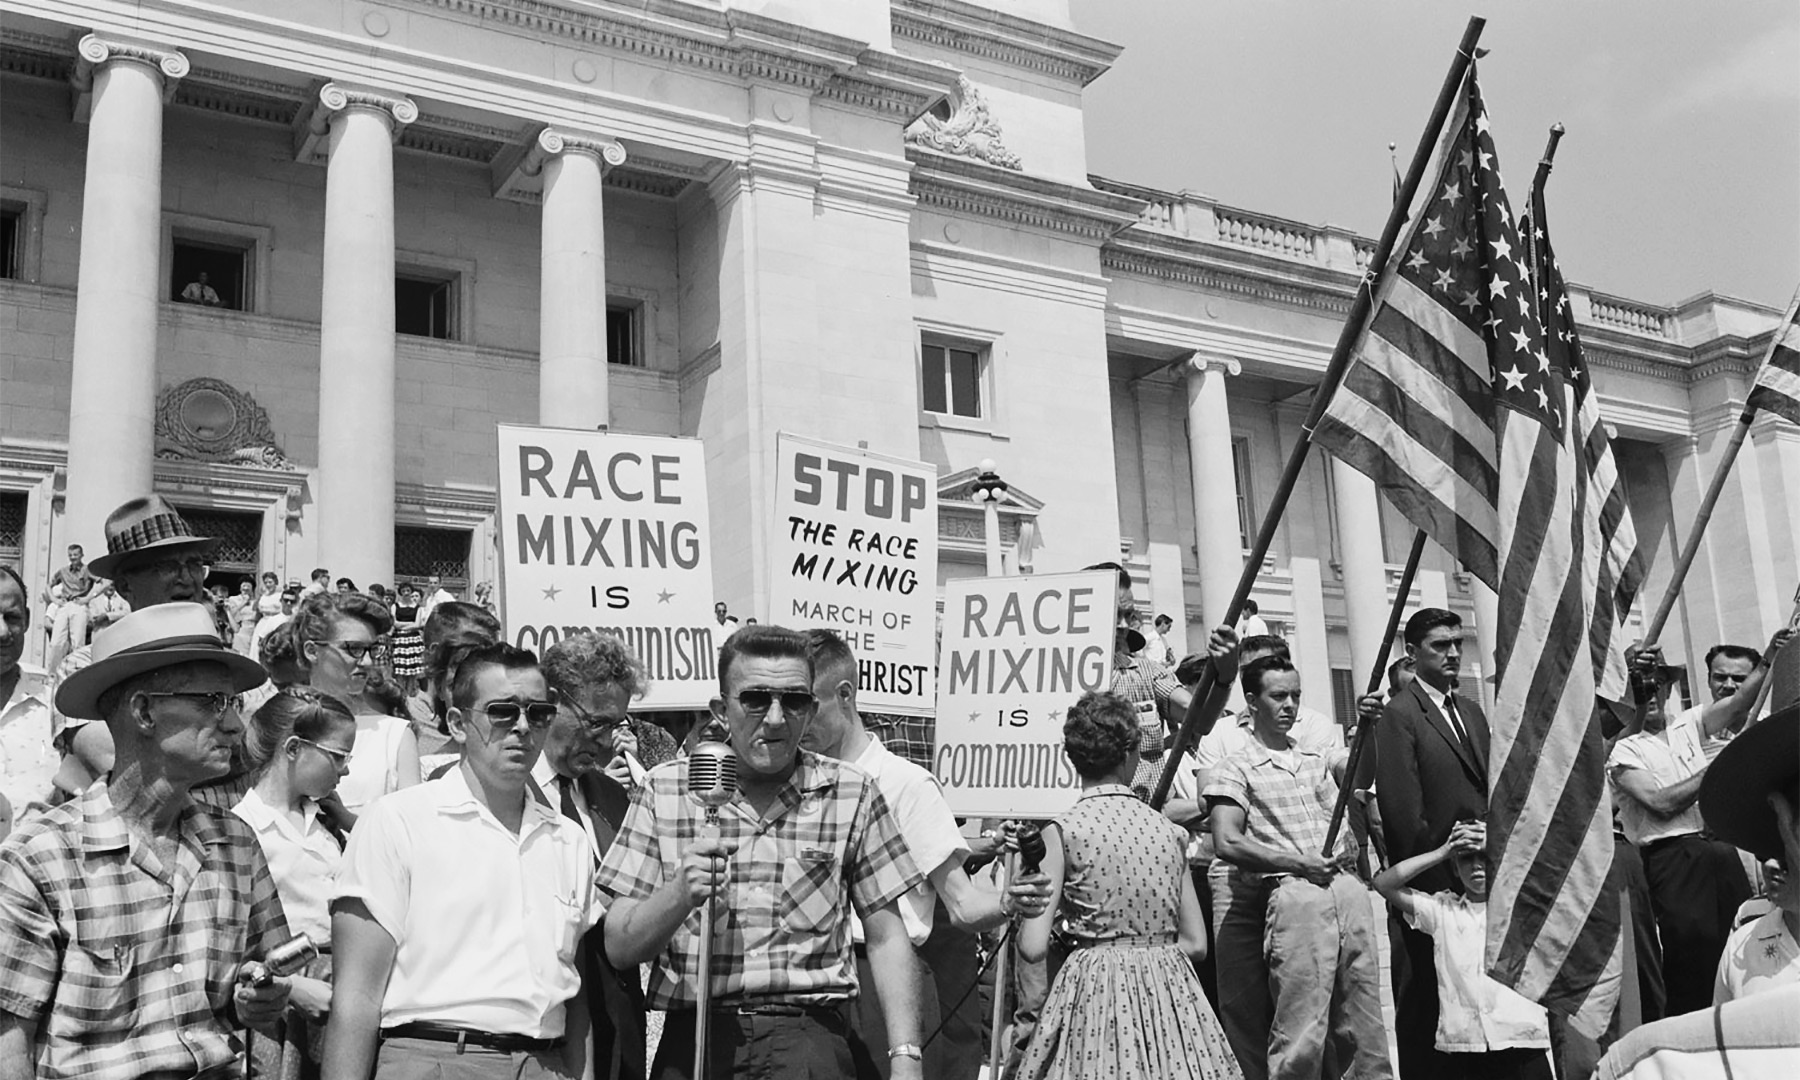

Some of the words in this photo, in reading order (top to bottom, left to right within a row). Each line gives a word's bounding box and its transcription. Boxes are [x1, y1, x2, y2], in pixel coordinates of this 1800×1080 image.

[519, 445, 682, 504] RACE
[794, 452, 926, 523] STOP
[517, 514, 700, 570] MIXING
[788, 516, 837, 546] THE
[848, 529, 919, 559] RACE
[792, 553, 918, 595] MIXING
[591, 586, 630, 609] IS
[792, 599, 873, 626] MARCH
[883, 612, 911, 631] OF
[963, 588, 1093, 638] RACE
[858, 659, 928, 696] HRIST
[949, 646, 1104, 695] MIXING
[998, 709, 1029, 727] IS
[936, 743, 1082, 788] communis
